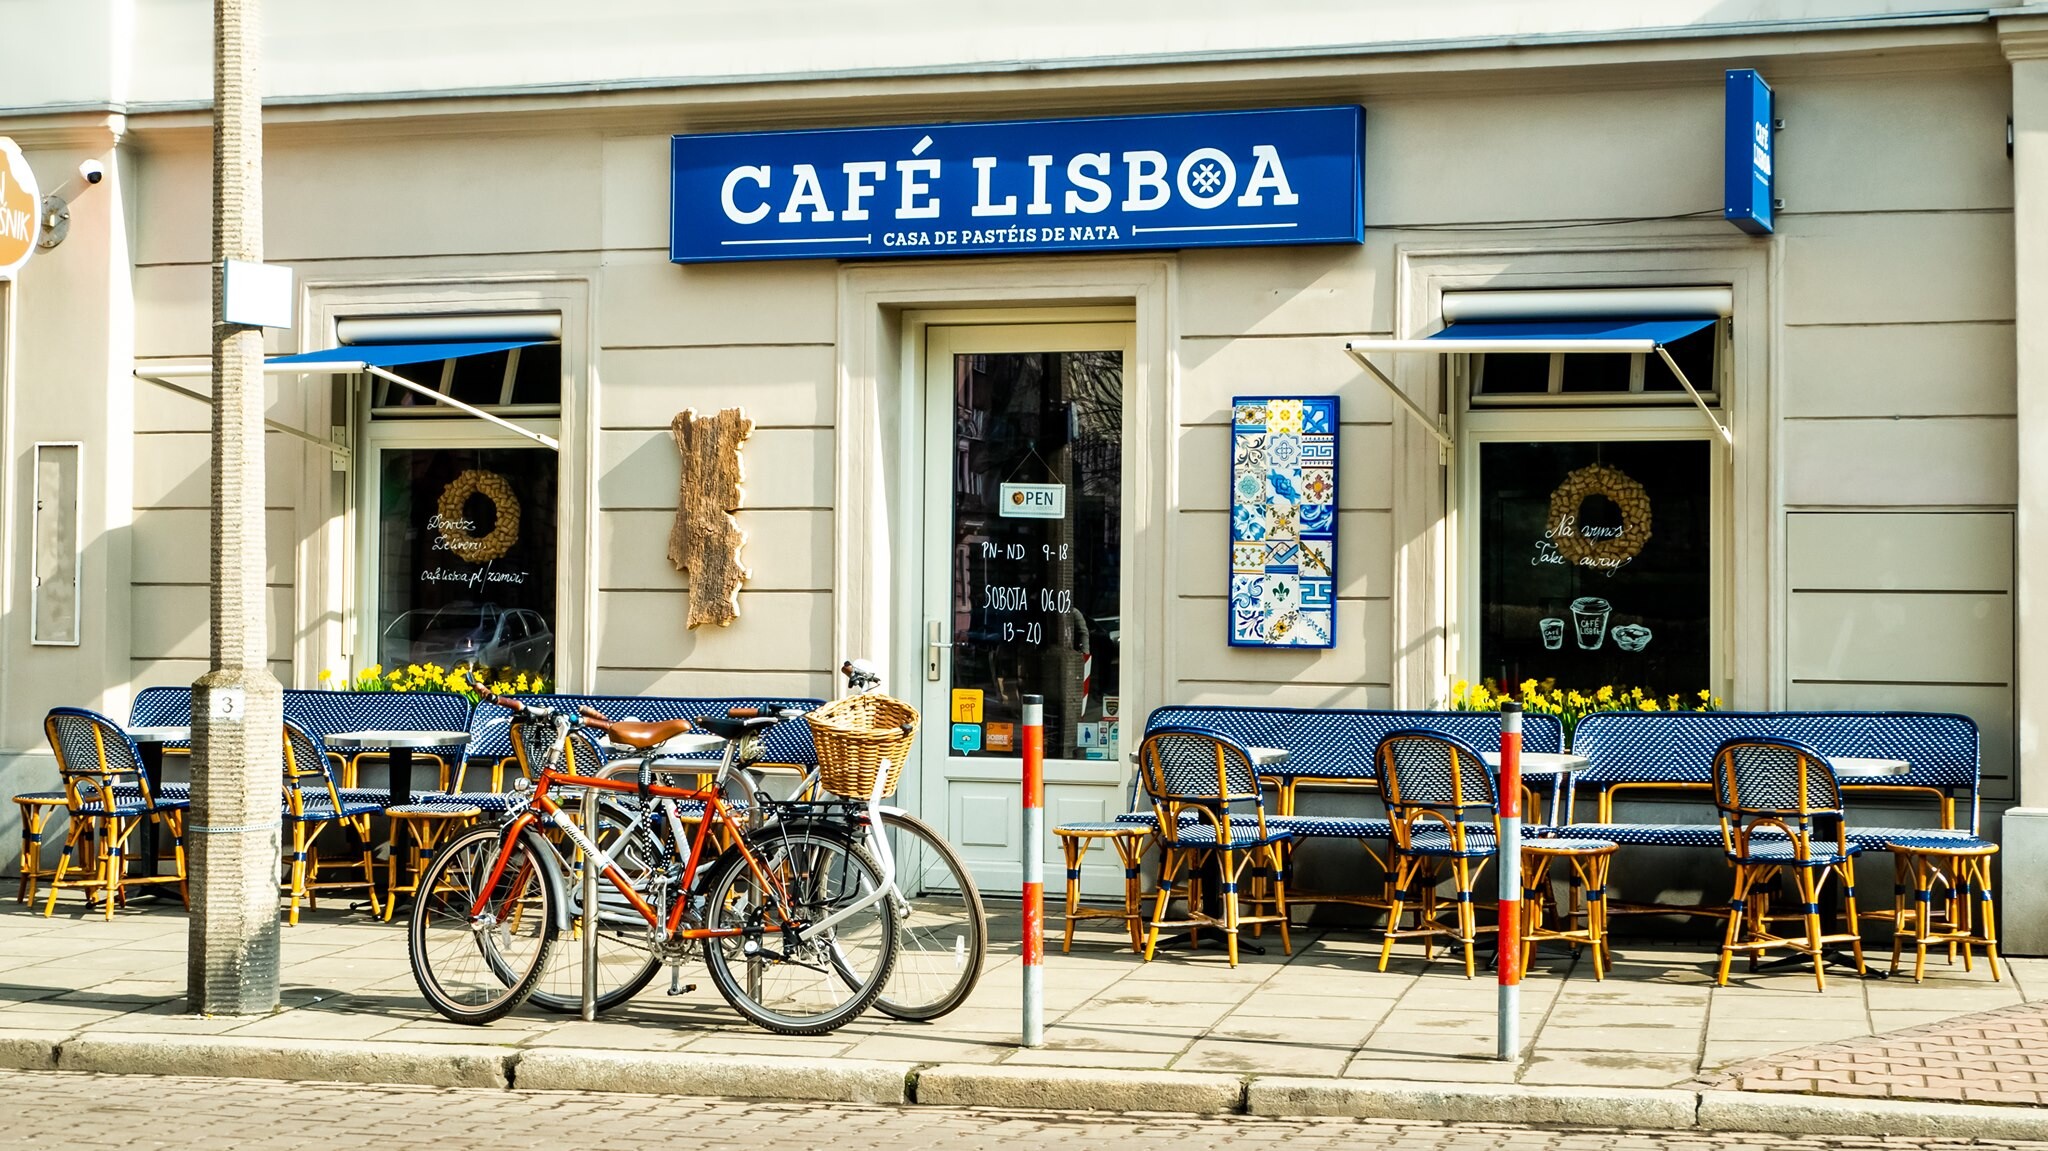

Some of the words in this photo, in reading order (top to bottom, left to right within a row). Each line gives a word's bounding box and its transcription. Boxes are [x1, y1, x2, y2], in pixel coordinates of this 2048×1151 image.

[719, 134, 942, 225] CAFÉ
[970, 143, 1300, 219] LISBOA
[883, 232, 931, 246] CASA
[934, 231, 957, 245] DE
[961, 224, 1037, 244] PASTÉIS
[1041, 228, 1065, 242] DE
[1069, 226, 1120, 241] NATA
[1545, 513, 1575, 539] Na
[1531, 540, 1567, 566] Take
[1579, 556, 1633, 578] away
[982, 584, 1028, 611] SOBOTA
[222, 697, 234, 713] 3
